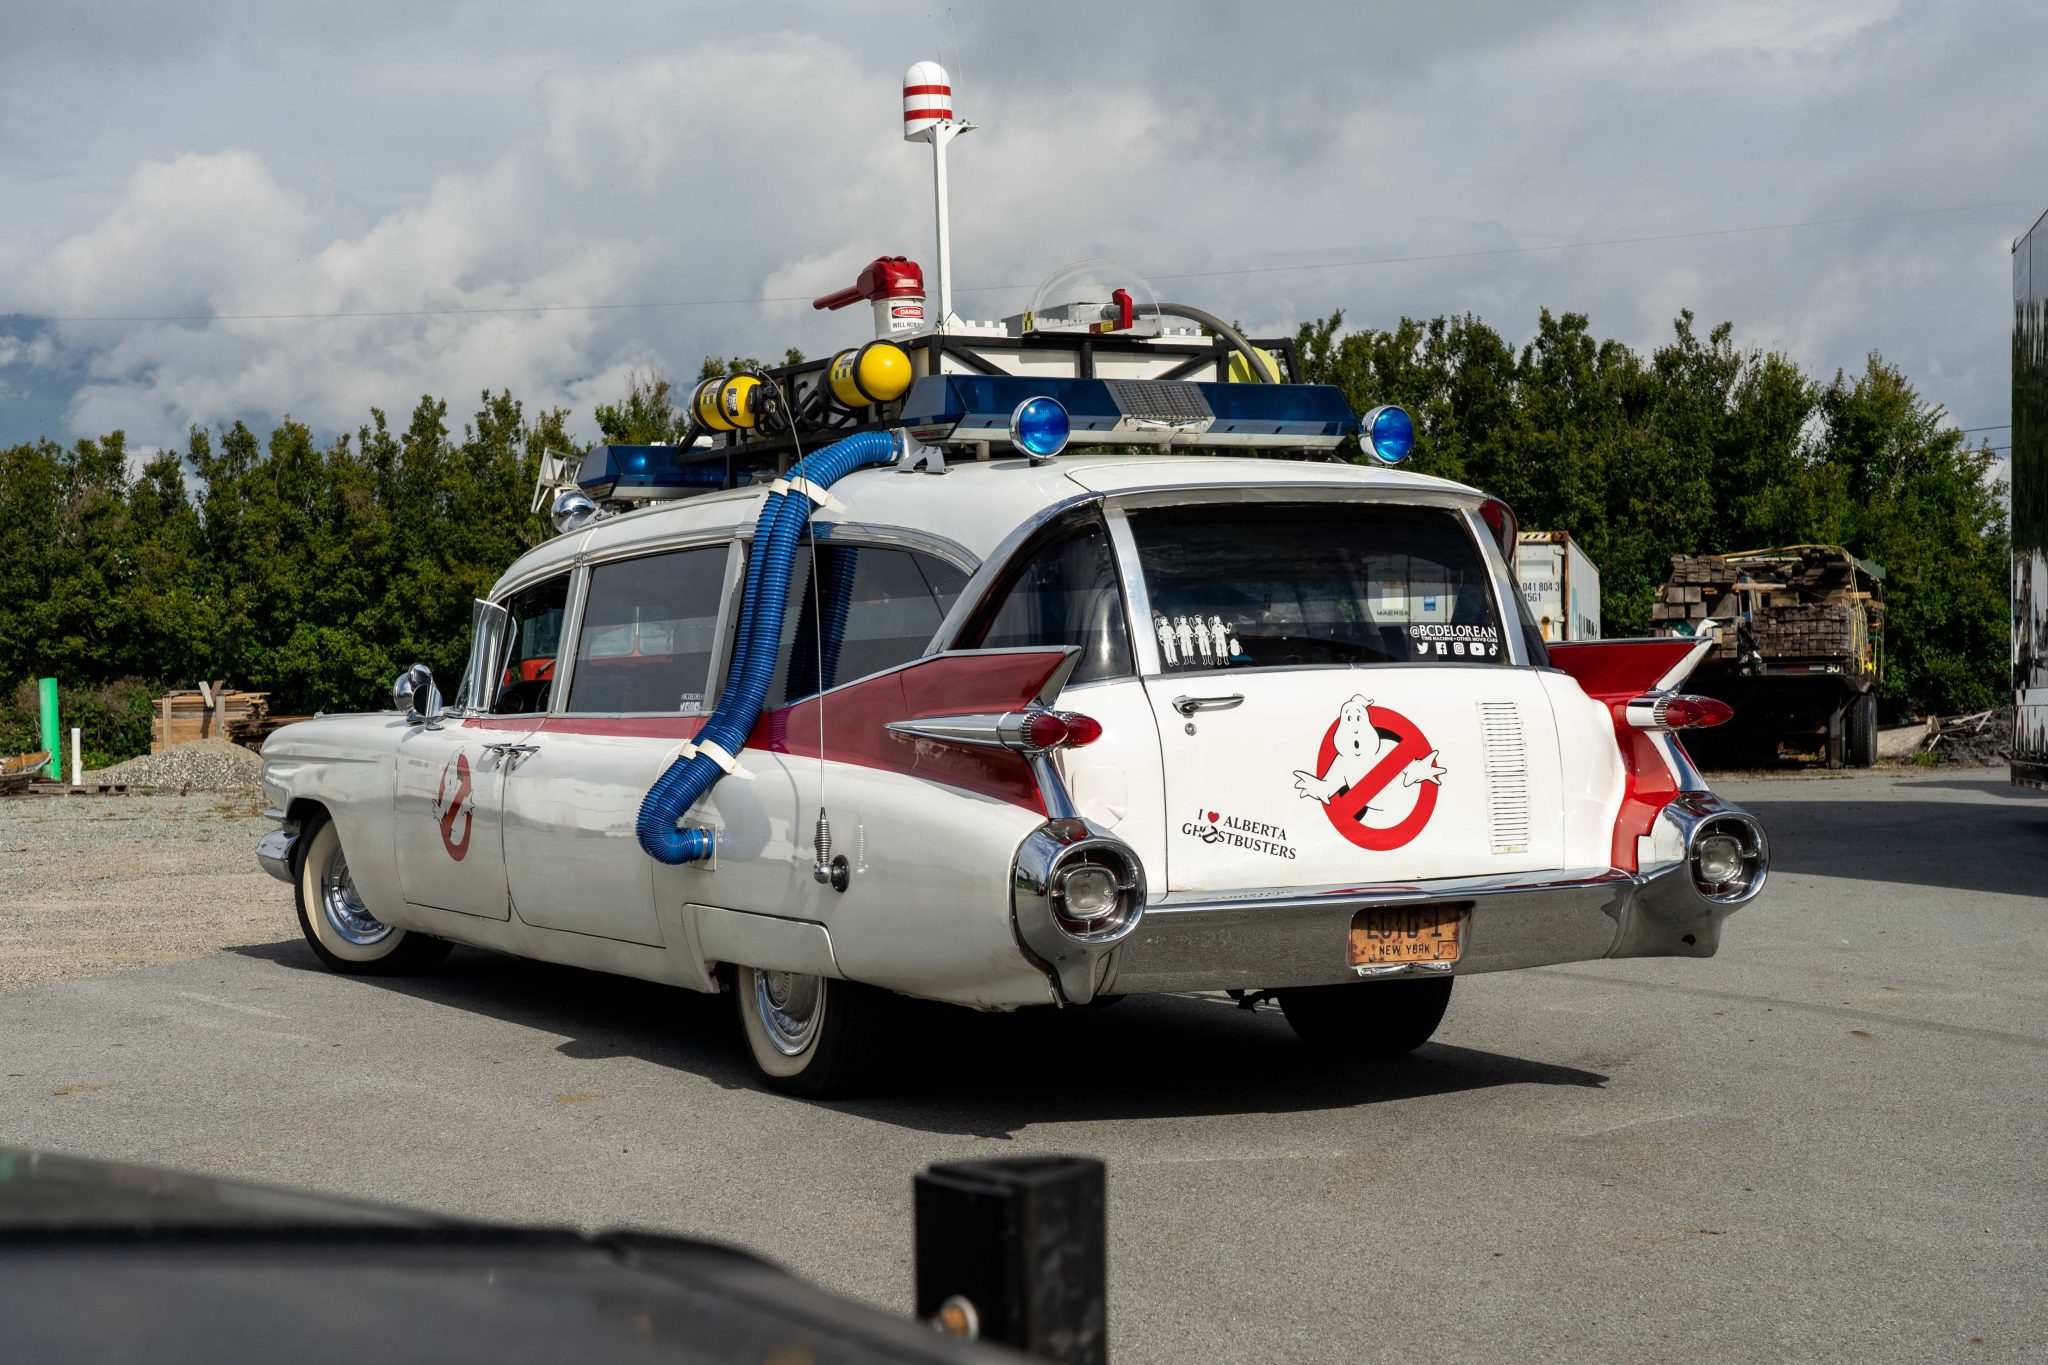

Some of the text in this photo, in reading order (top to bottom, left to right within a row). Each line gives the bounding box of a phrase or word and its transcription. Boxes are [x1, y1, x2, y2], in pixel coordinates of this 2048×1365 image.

[1523, 582, 1536, 591] 041
[1539, 582, 1553, 591] 804
[1409, 624, 1497, 638] @BCDELOREAN
[1198, 809, 1287, 841] I ALBERTA
[1379, 943, 1430, 956] NEW YORK
